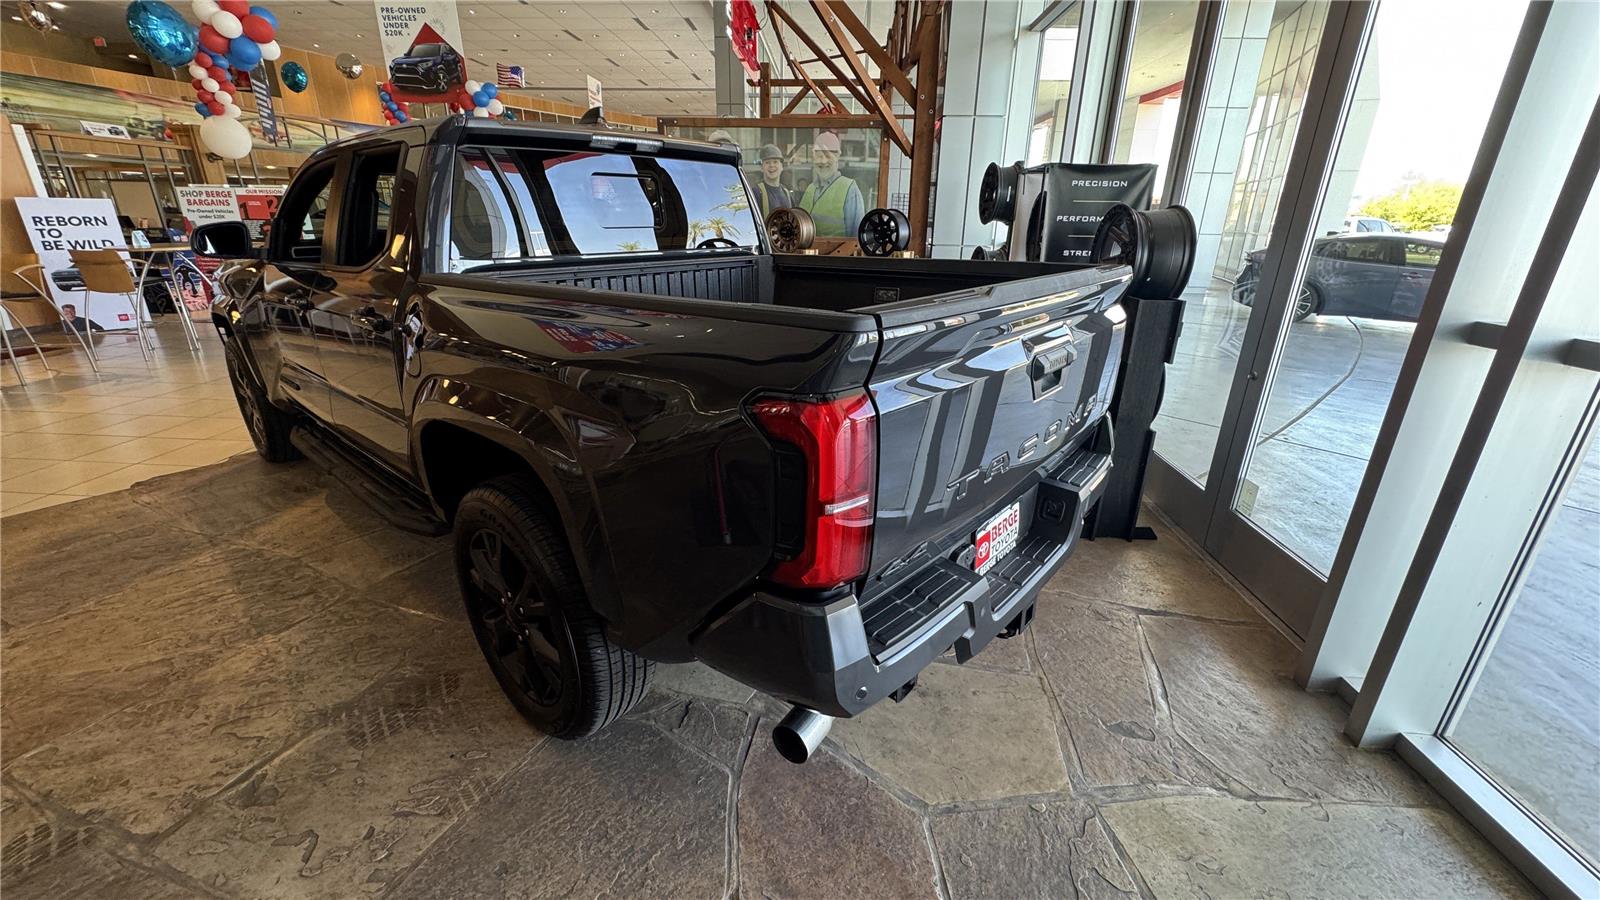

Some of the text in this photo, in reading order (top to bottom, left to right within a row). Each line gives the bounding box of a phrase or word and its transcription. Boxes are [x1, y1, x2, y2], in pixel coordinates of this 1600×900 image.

[180, 190, 232, 198] SHOP BERGE
[187, 199, 230, 207] BARGAINS
[31, 216, 108, 226] REBORN
[35, 228, 62, 239] TO
[40, 239, 115, 251] BE WILD
[946, 393, 1098, 500] TACOMA
[991, 509, 1018, 541] BERGE
[991, 526, 1018, 556] TOYOTA
[997, 540, 1017, 562] TOYOTA
